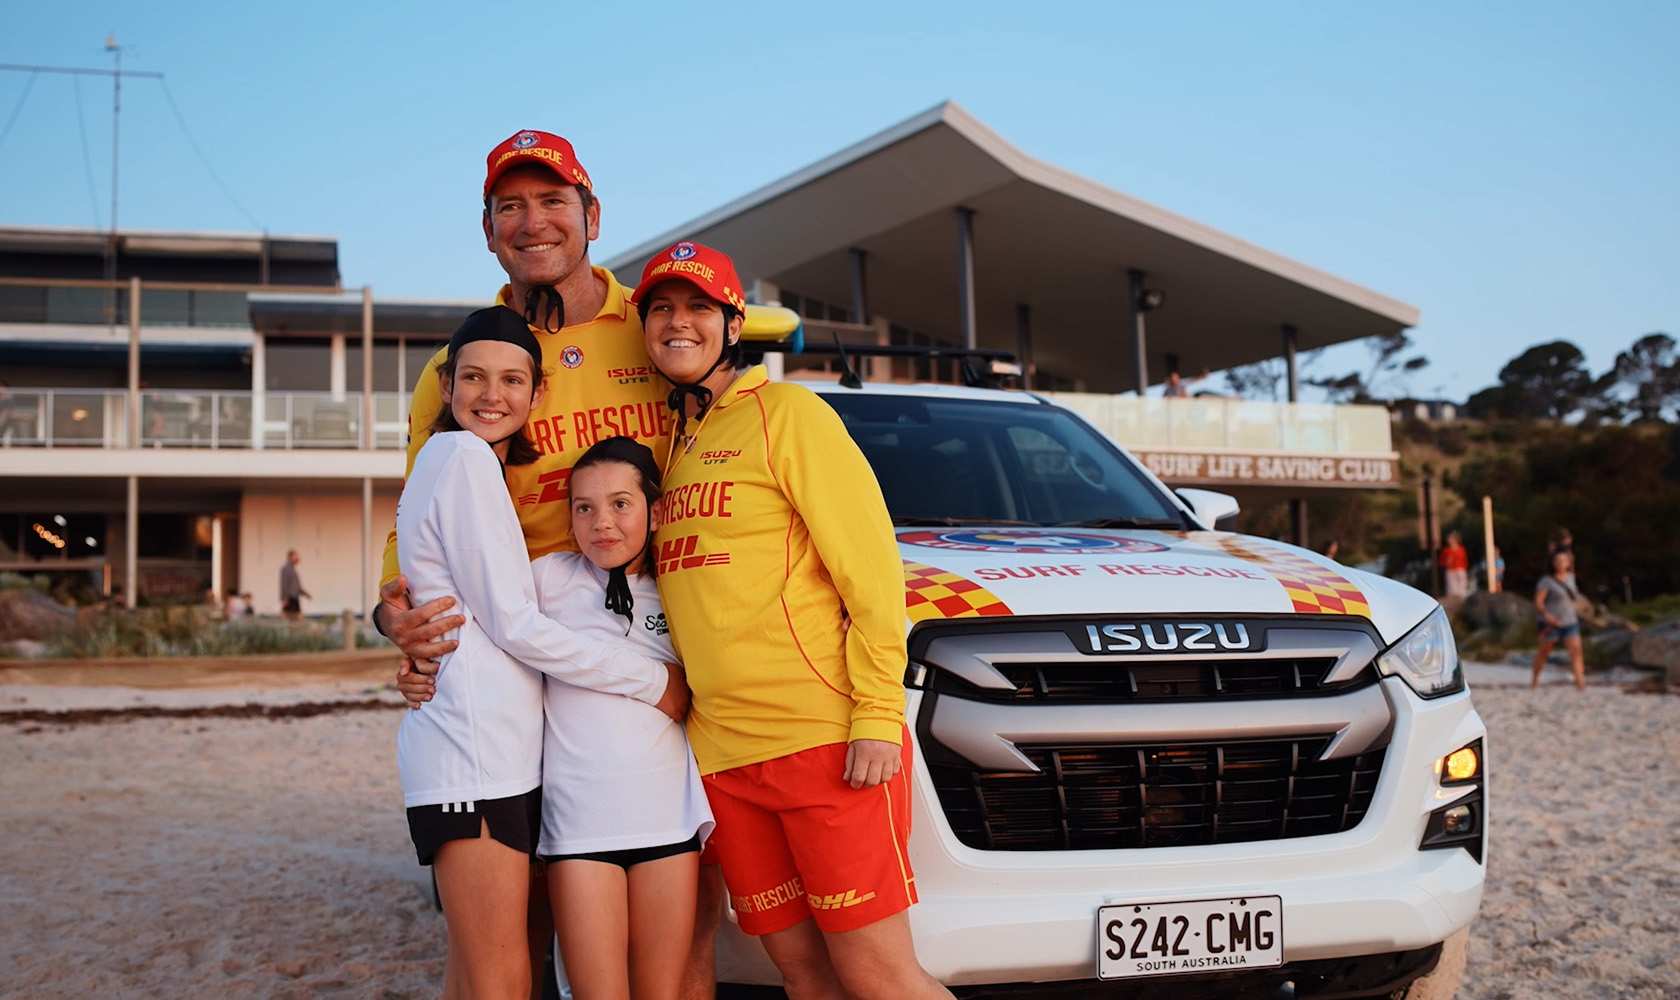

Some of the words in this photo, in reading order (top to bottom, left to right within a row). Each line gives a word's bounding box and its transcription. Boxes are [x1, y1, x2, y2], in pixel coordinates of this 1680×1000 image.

[672, 260, 715, 283] RESCUE
[572, 400, 669, 448] RESCUE
[700, 449, 742, 459] ISUZU
[1146, 453, 1204, 477] SURF
[1208, 455, 1253, 478] LIFE
[1256, 457, 1335, 480] SAVING
[1339, 459, 1393, 482] CLUB
[661, 481, 734, 525] RESCUE
[973, 564, 1087, 580] SURF
[1097, 564, 1266, 581] RESCUE
[1086, 622, 1251, 652] ISUZU
[752, 877, 804, 912] RESCUE
[807, 888, 863, 910] DHL
[1136, 960, 1176, 971] SOUTH
[1182, 955, 1247, 968] AUSTRALIA
